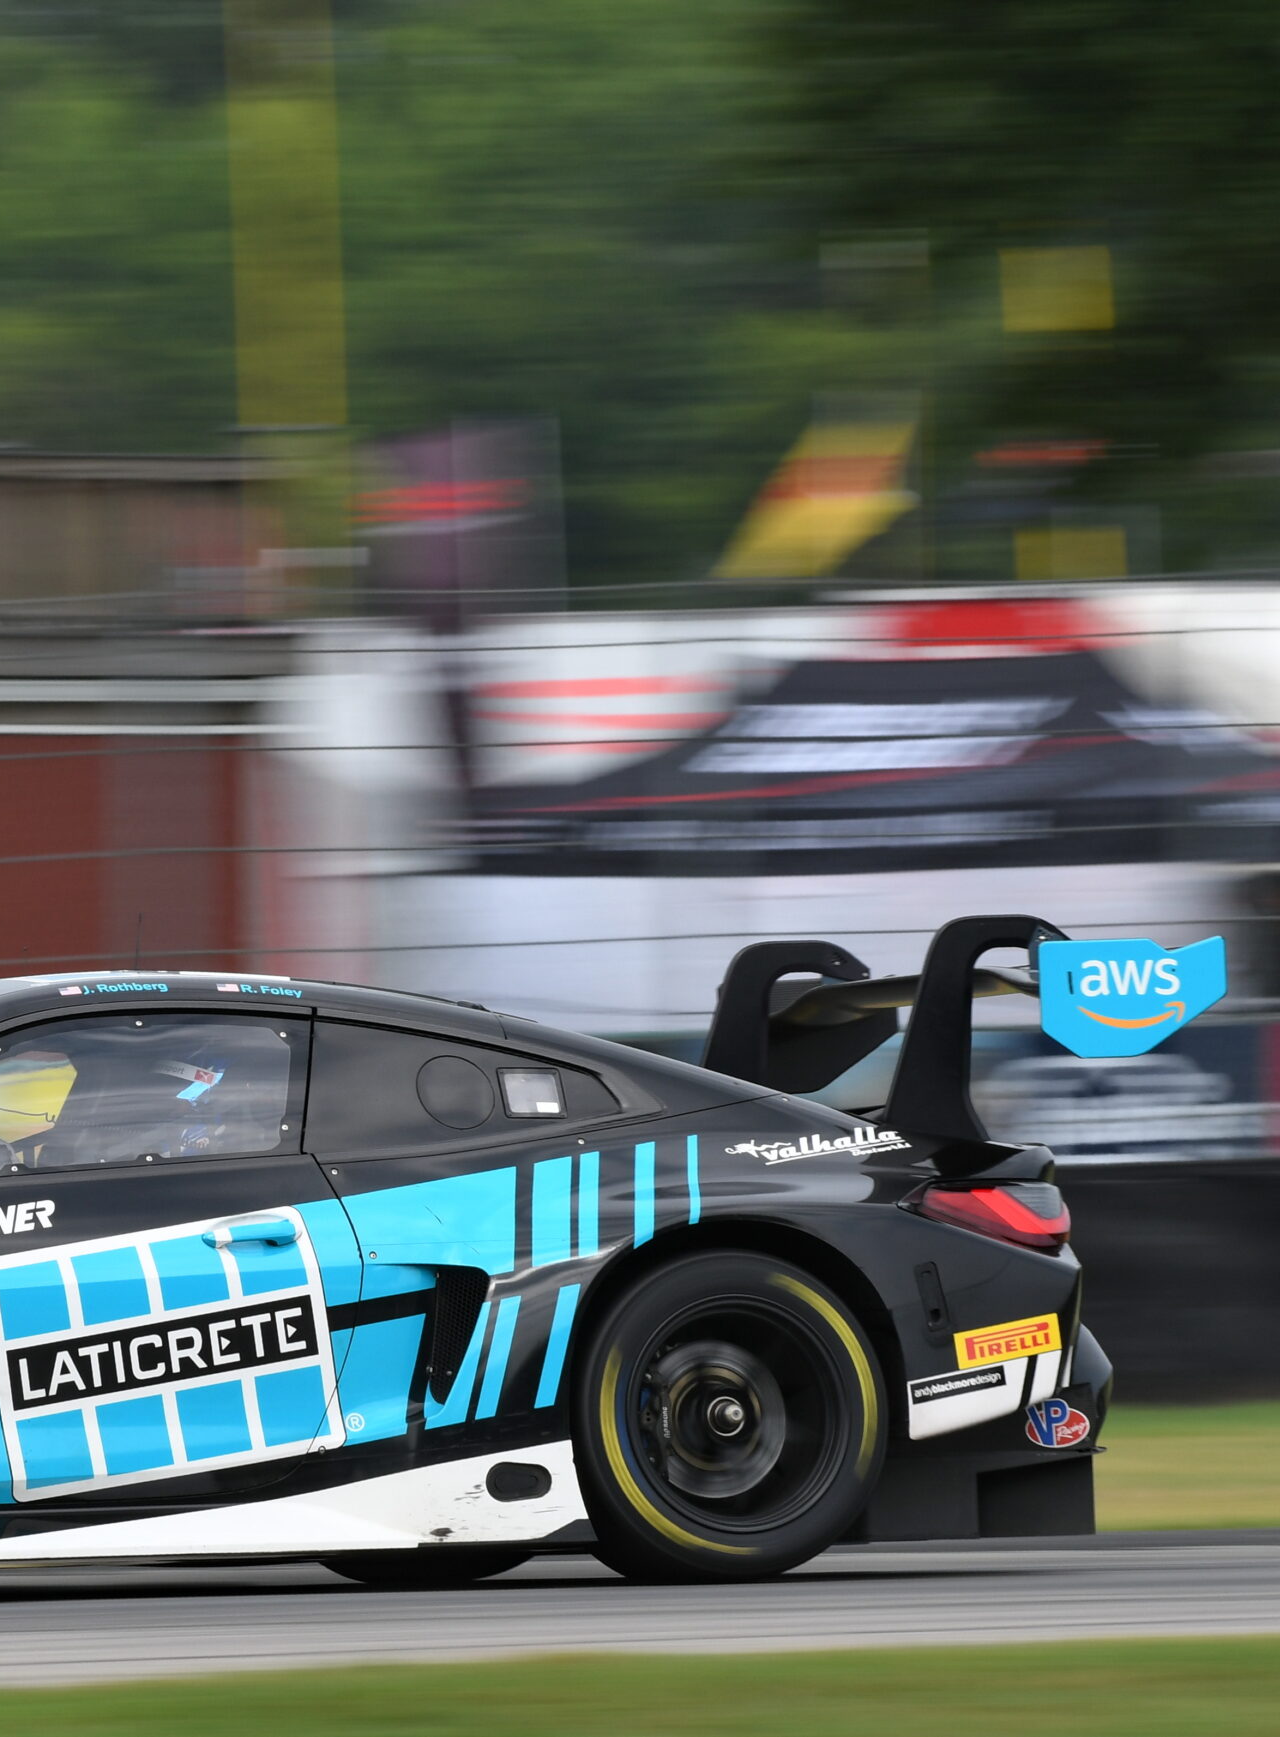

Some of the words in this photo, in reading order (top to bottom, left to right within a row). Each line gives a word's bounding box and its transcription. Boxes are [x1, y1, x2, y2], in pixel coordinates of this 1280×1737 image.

[83, 985, 96, 995] J.
[96, 982, 169, 993] Rothberg
[240, 984, 257, 994] R.
[260, 985, 302, 998] Foley
[1080, 958, 1181, 997] aws
[19, 1307, 307, 1400] LATICRETE
[965, 1322, 1050, 1361] PIRELLI
[914, 1371, 1001, 1399] andyblackmoredesign
[1026, 1399, 1069, 1446] VP
